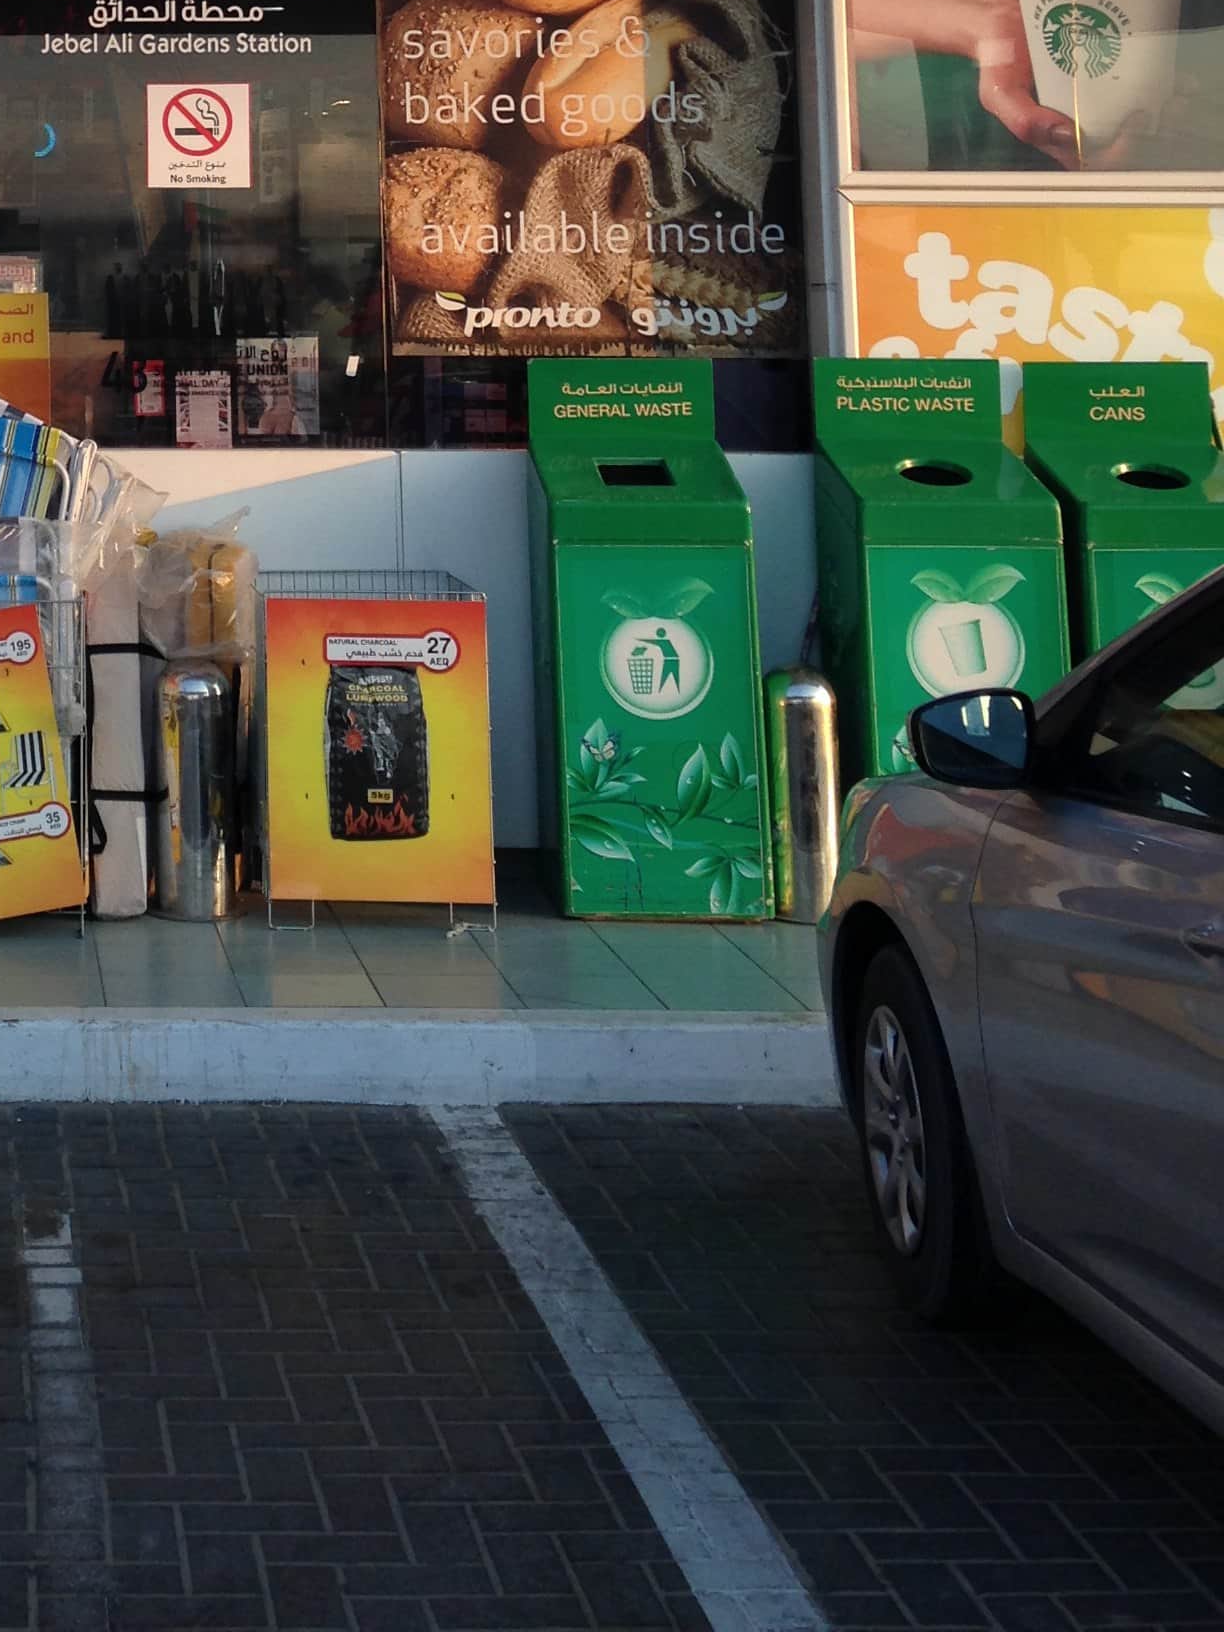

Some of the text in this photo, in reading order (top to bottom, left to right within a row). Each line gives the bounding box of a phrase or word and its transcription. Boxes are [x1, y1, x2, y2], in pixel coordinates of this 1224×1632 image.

[182, 0, 264, 22] محطة
[41, 33, 312, 55] Jebel Ali Gardens Station
[403, 16, 651, 59] savories &
[405, 82, 704, 136] baked goods
[170, 174, 227, 185] No Smoking
[421, 213, 786, 254] available inside
[464, 300, 601, 335] pronto
[633, 297, 761, 336] برونتو
[1, 329, 35, 345] and
[247, 364, 288, 376] UNION
[202, 378, 219, 388] DAY
[561, 381, 683, 396] النفايات العامة
[1089, 384, 1146, 399] العلب
[553, 401, 693, 420] GENERAL WASTE
[836, 395, 975, 413] PLASTIC WASTE
[1089, 406, 1146, 422] CANS
[10, 639, 31, 653] 195
[427, 637, 451, 654] 27
[429, 657, 449, 666] AED
[46, 811, 61, 824] 35
